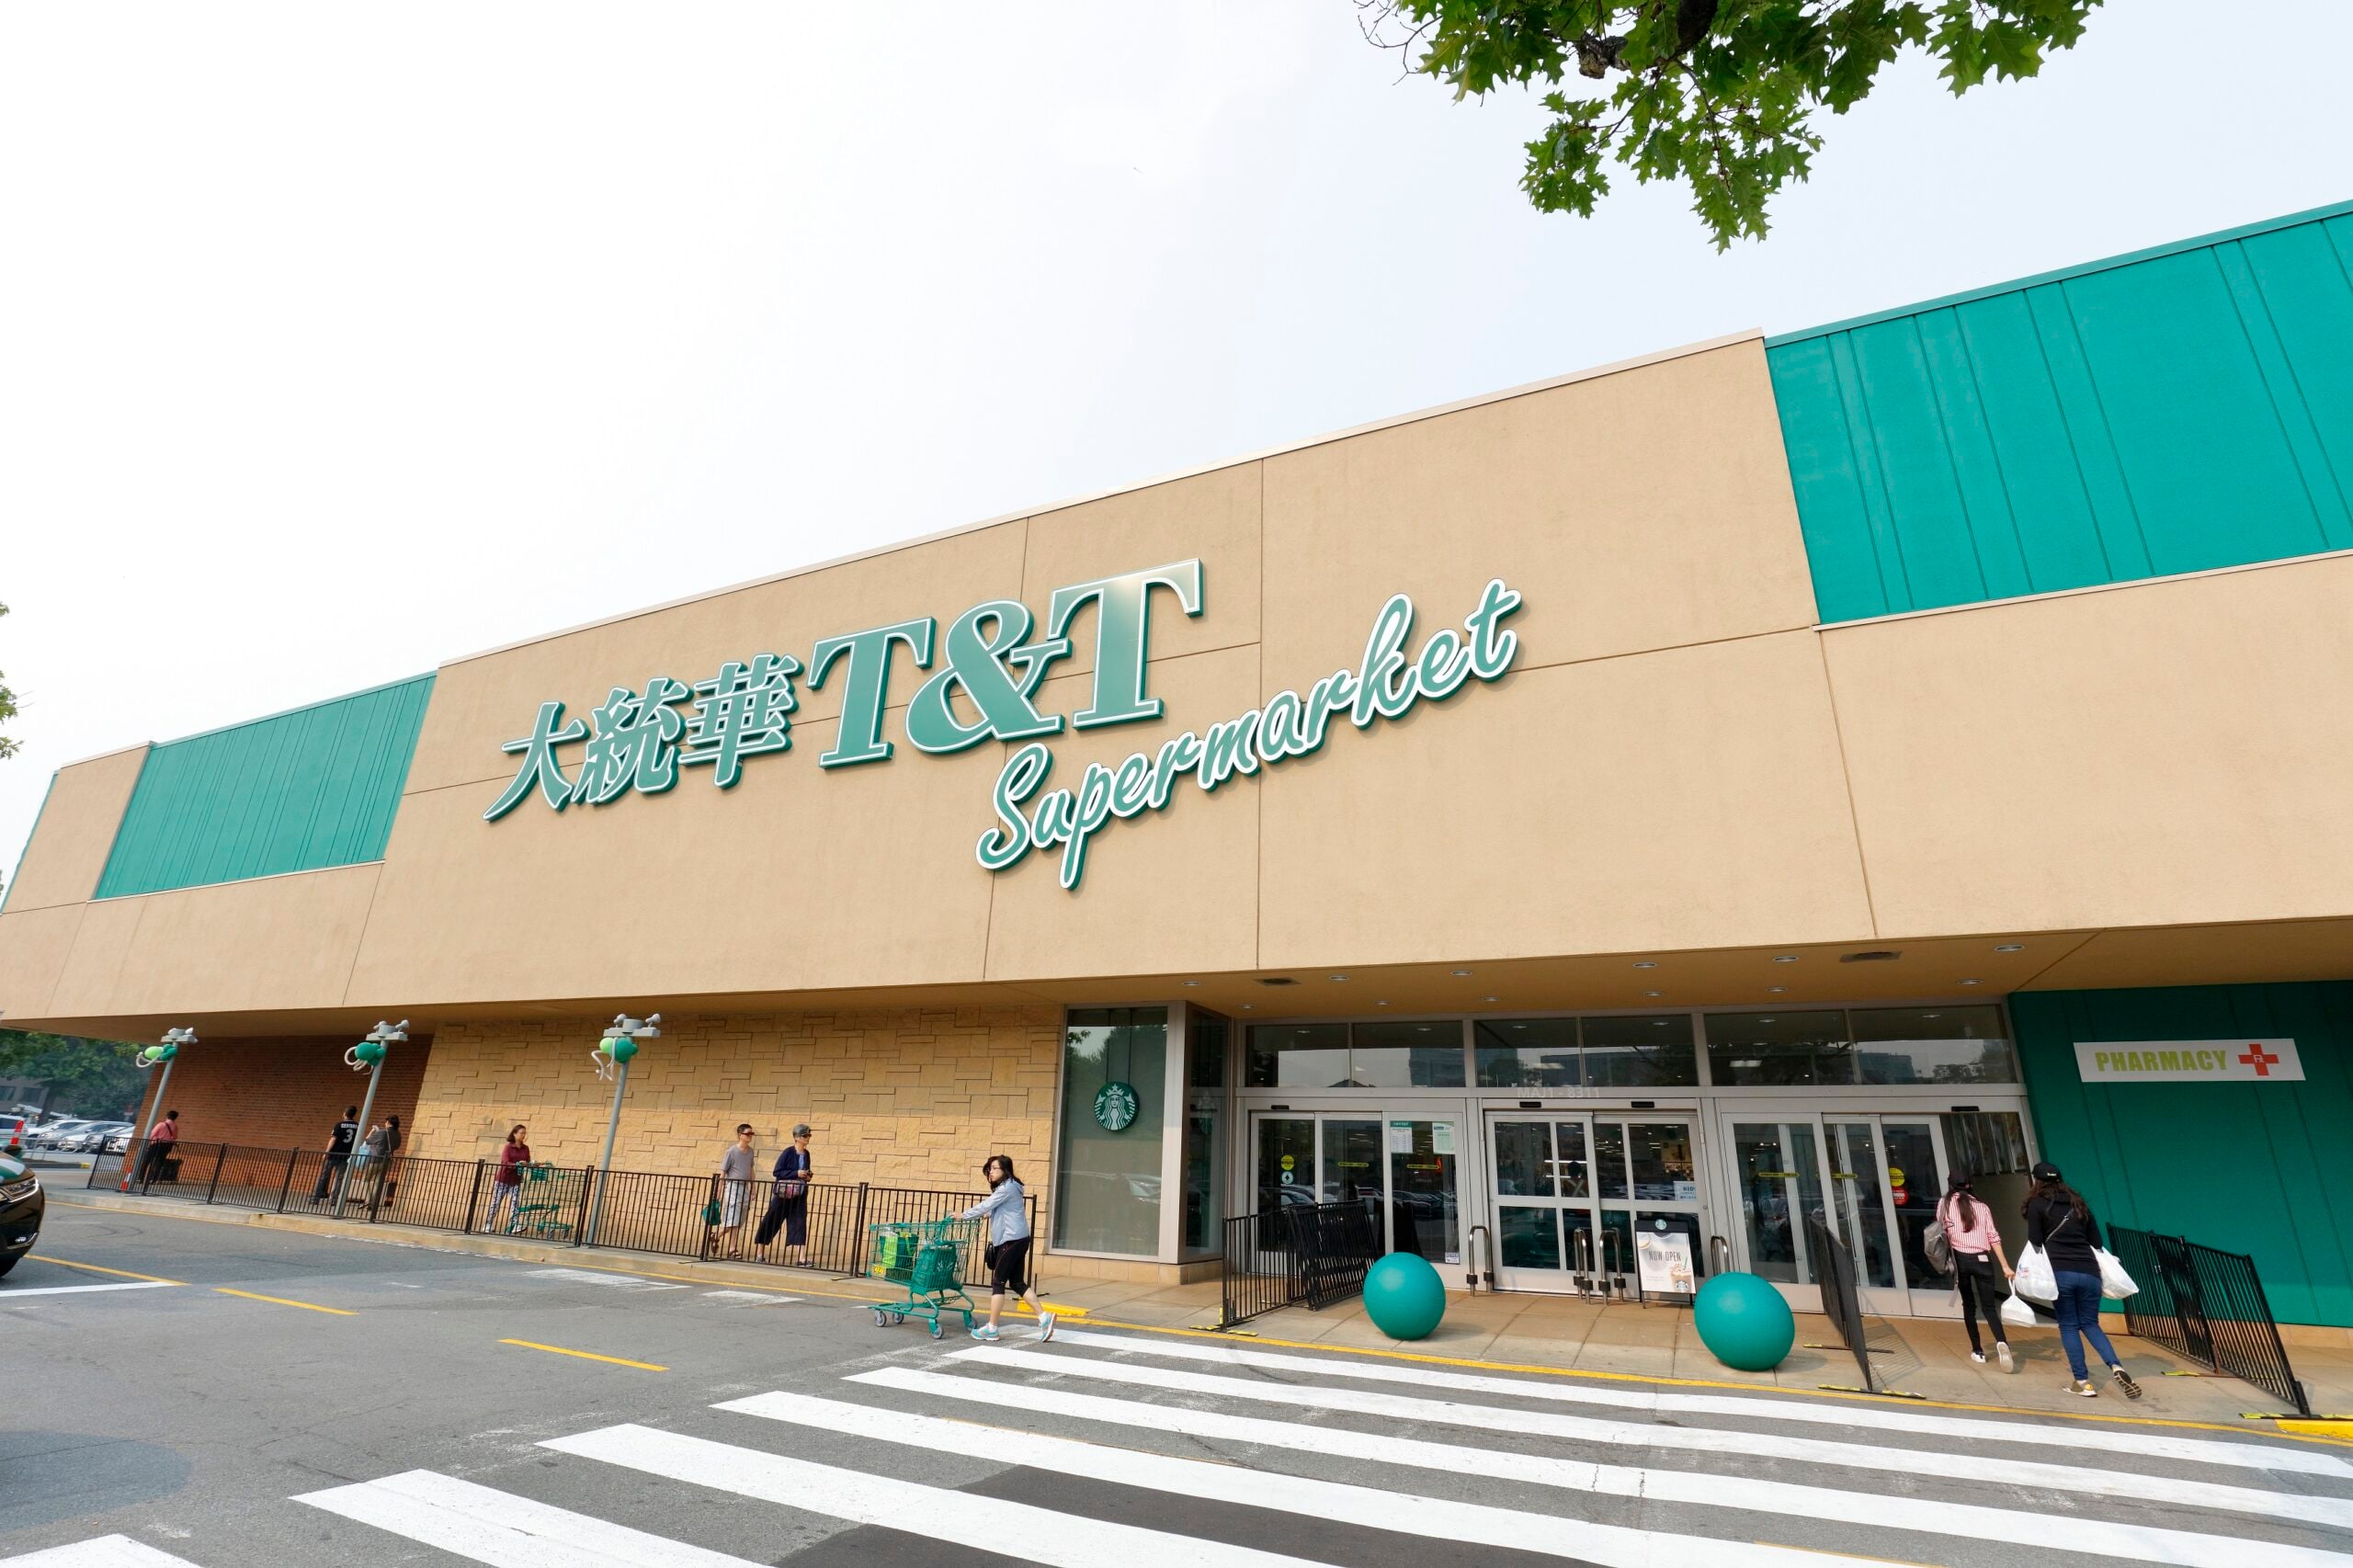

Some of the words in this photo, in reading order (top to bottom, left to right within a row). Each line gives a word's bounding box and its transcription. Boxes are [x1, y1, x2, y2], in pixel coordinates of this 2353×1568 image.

[806, 557, 1204, 769] T&T
[483, 652, 800, 824] 大統華
[975, 577, 1523, 891] Supermarket
[2095, 1050, 2227, 1072] PHARMACY
[343, 1129, 354, 1143] 3
[1649, 1251, 1663, 1262] NOW
[1665, 1251, 1681, 1262] OPEN
